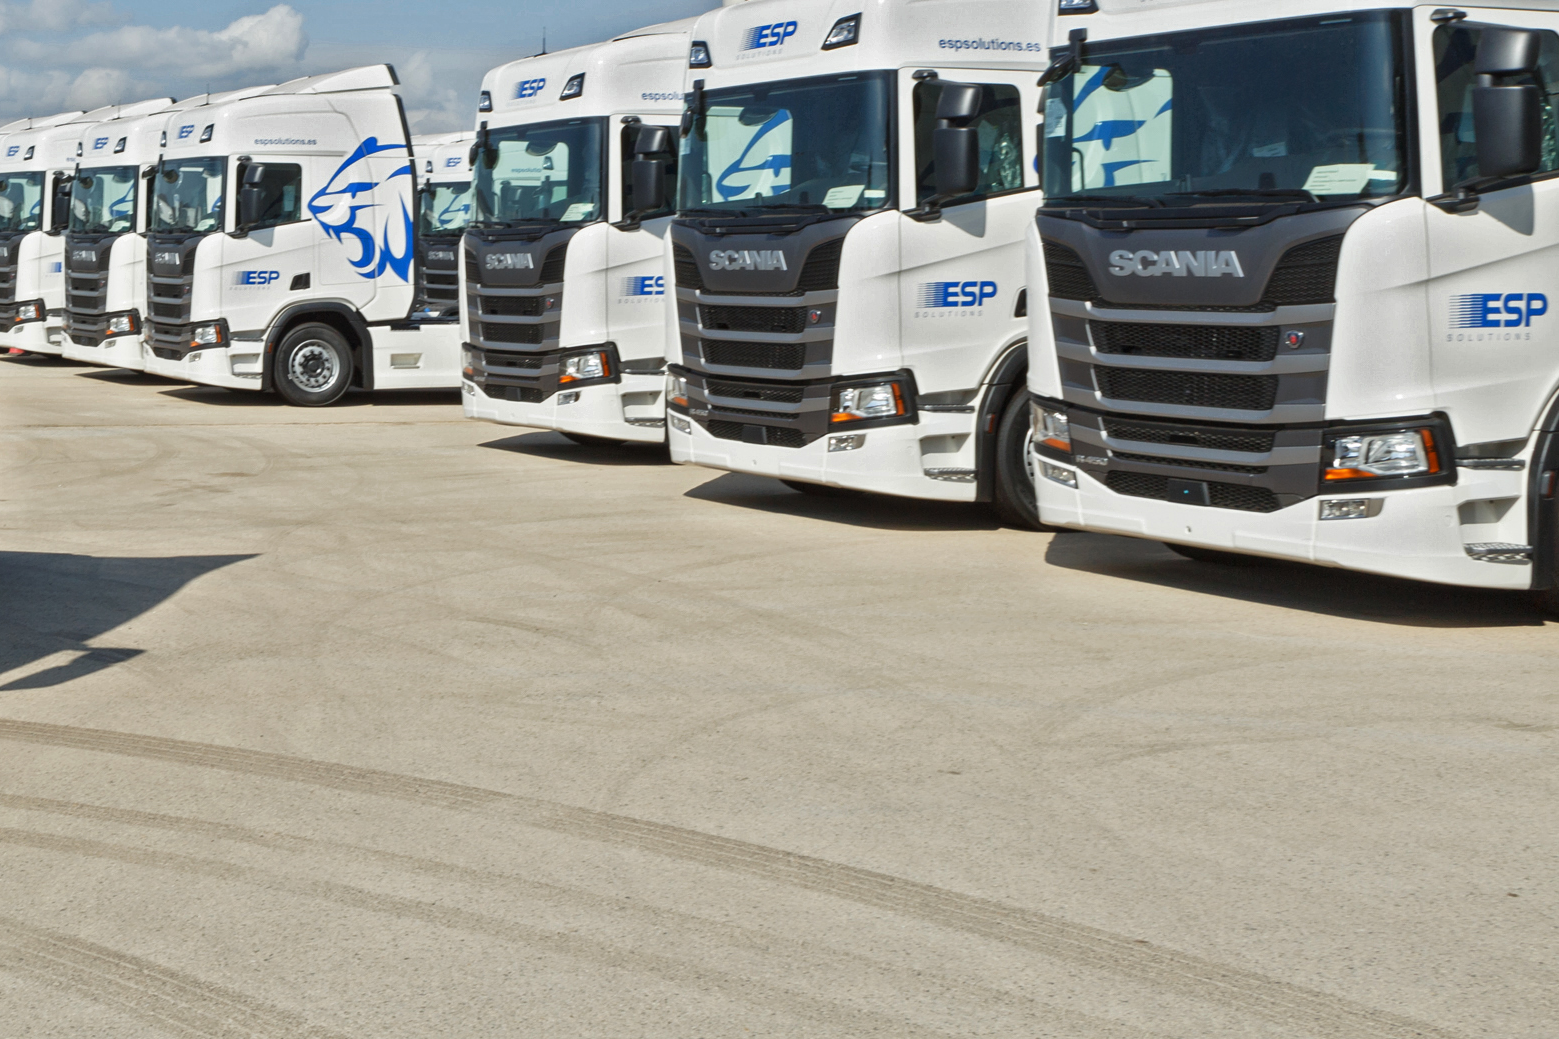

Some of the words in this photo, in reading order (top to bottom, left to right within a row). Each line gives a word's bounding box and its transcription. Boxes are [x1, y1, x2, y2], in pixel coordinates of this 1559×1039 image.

[751, 20, 798, 48] ESP
[938, 38, 1041, 52] espsolutions.es
[516, 77, 546, 99] ESP
[485, 253, 534, 269] SCANIA
[708, 249, 788, 272] SCANIA
[1108, 249, 1245, 278] SCANIA
[239, 270, 280, 285] ESP
[631, 275, 665, 296] ES
[932, 281, 998, 308] ESP
[1469, 292, 1548, 328] ESP
